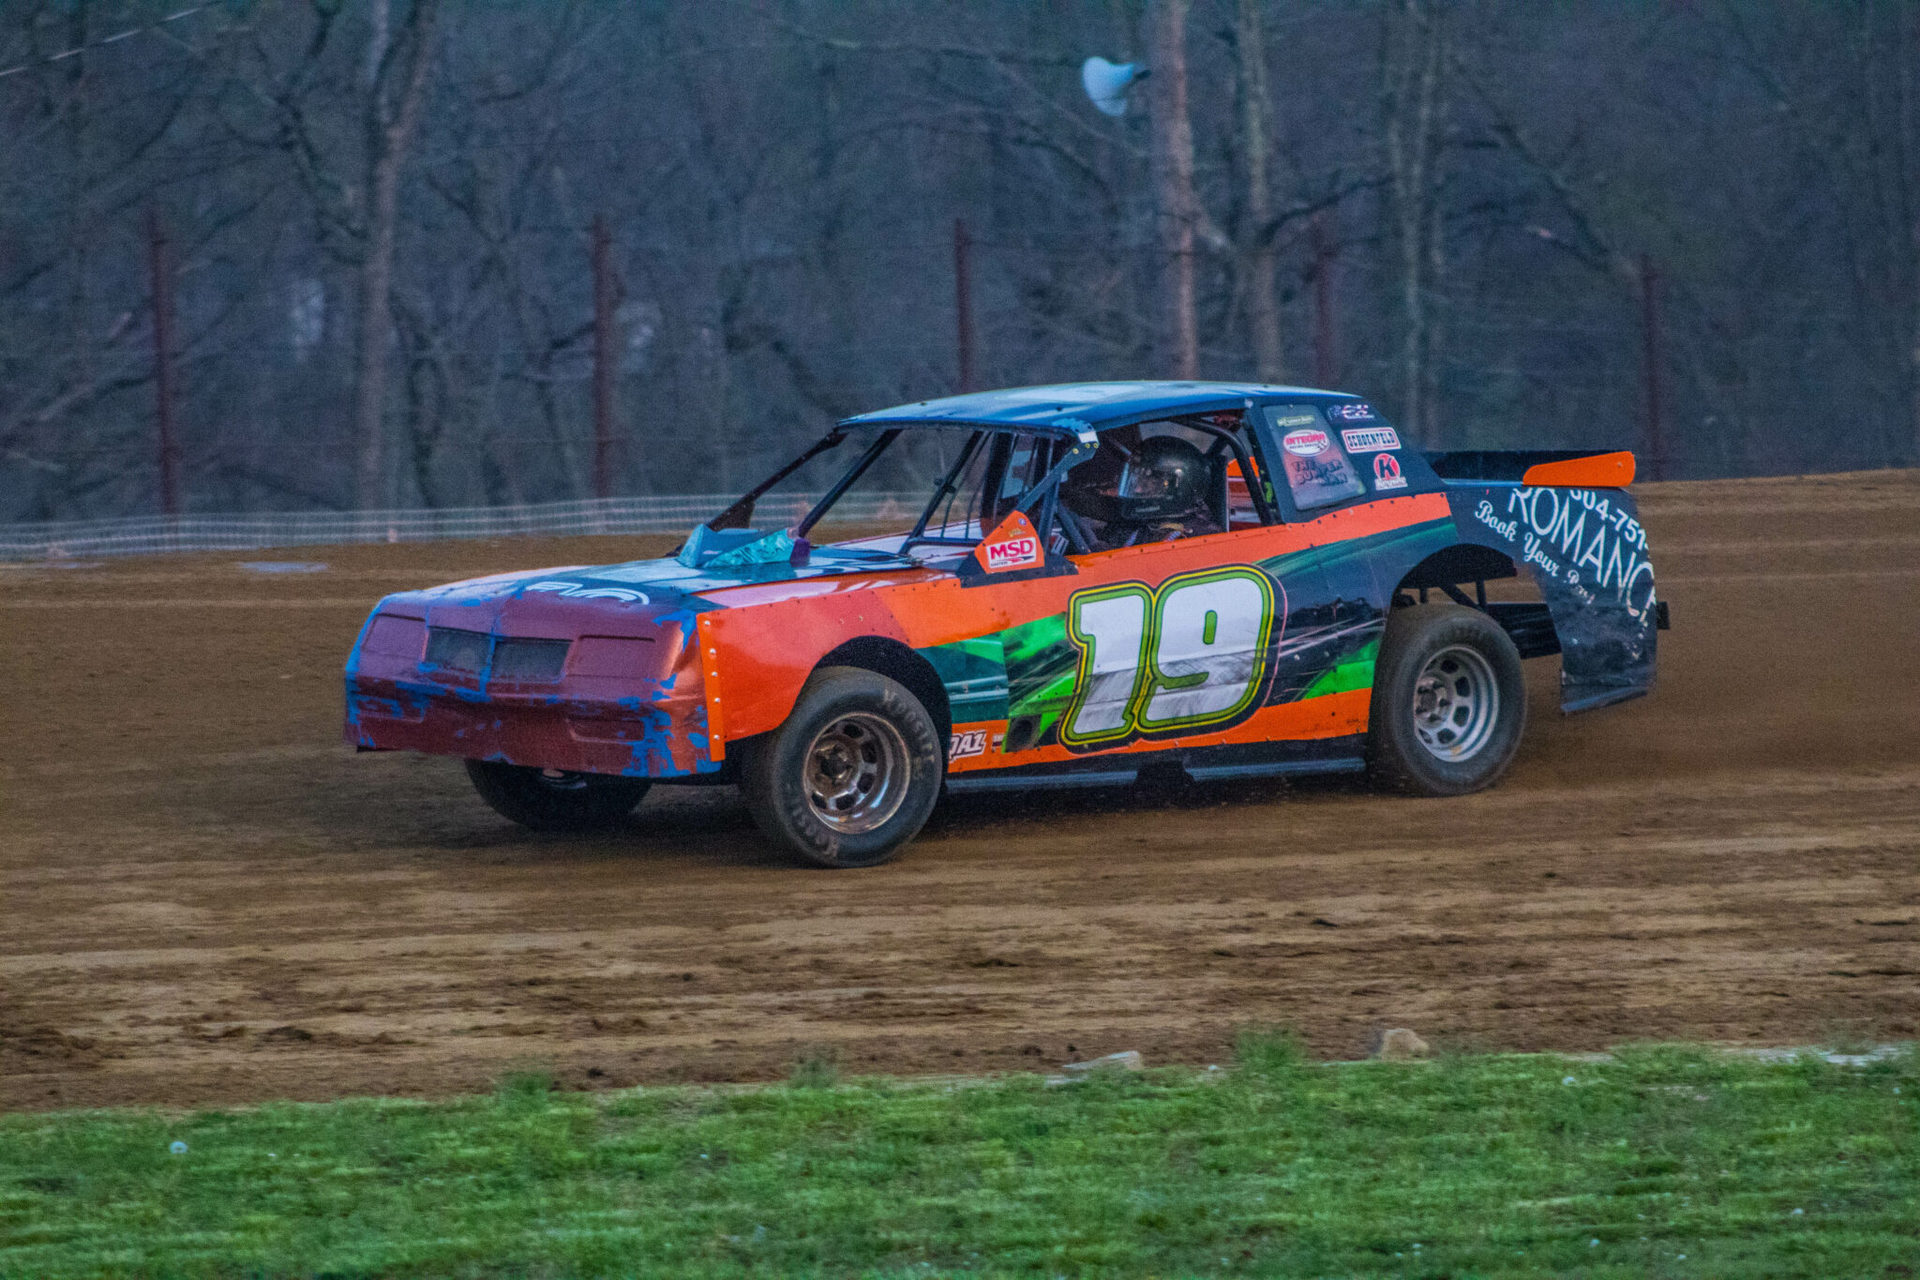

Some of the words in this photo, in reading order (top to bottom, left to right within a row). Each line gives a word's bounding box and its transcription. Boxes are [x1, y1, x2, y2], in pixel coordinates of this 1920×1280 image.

[1347, 432, 1396, 447] SCHOENFELD
[1379, 457, 1396, 478] K
[1475, 500, 1517, 541] Book
[1523, 532, 1560, 577] Your
[989, 539, 1034, 560] MSD
[1059, 565, 1276, 748] 19
